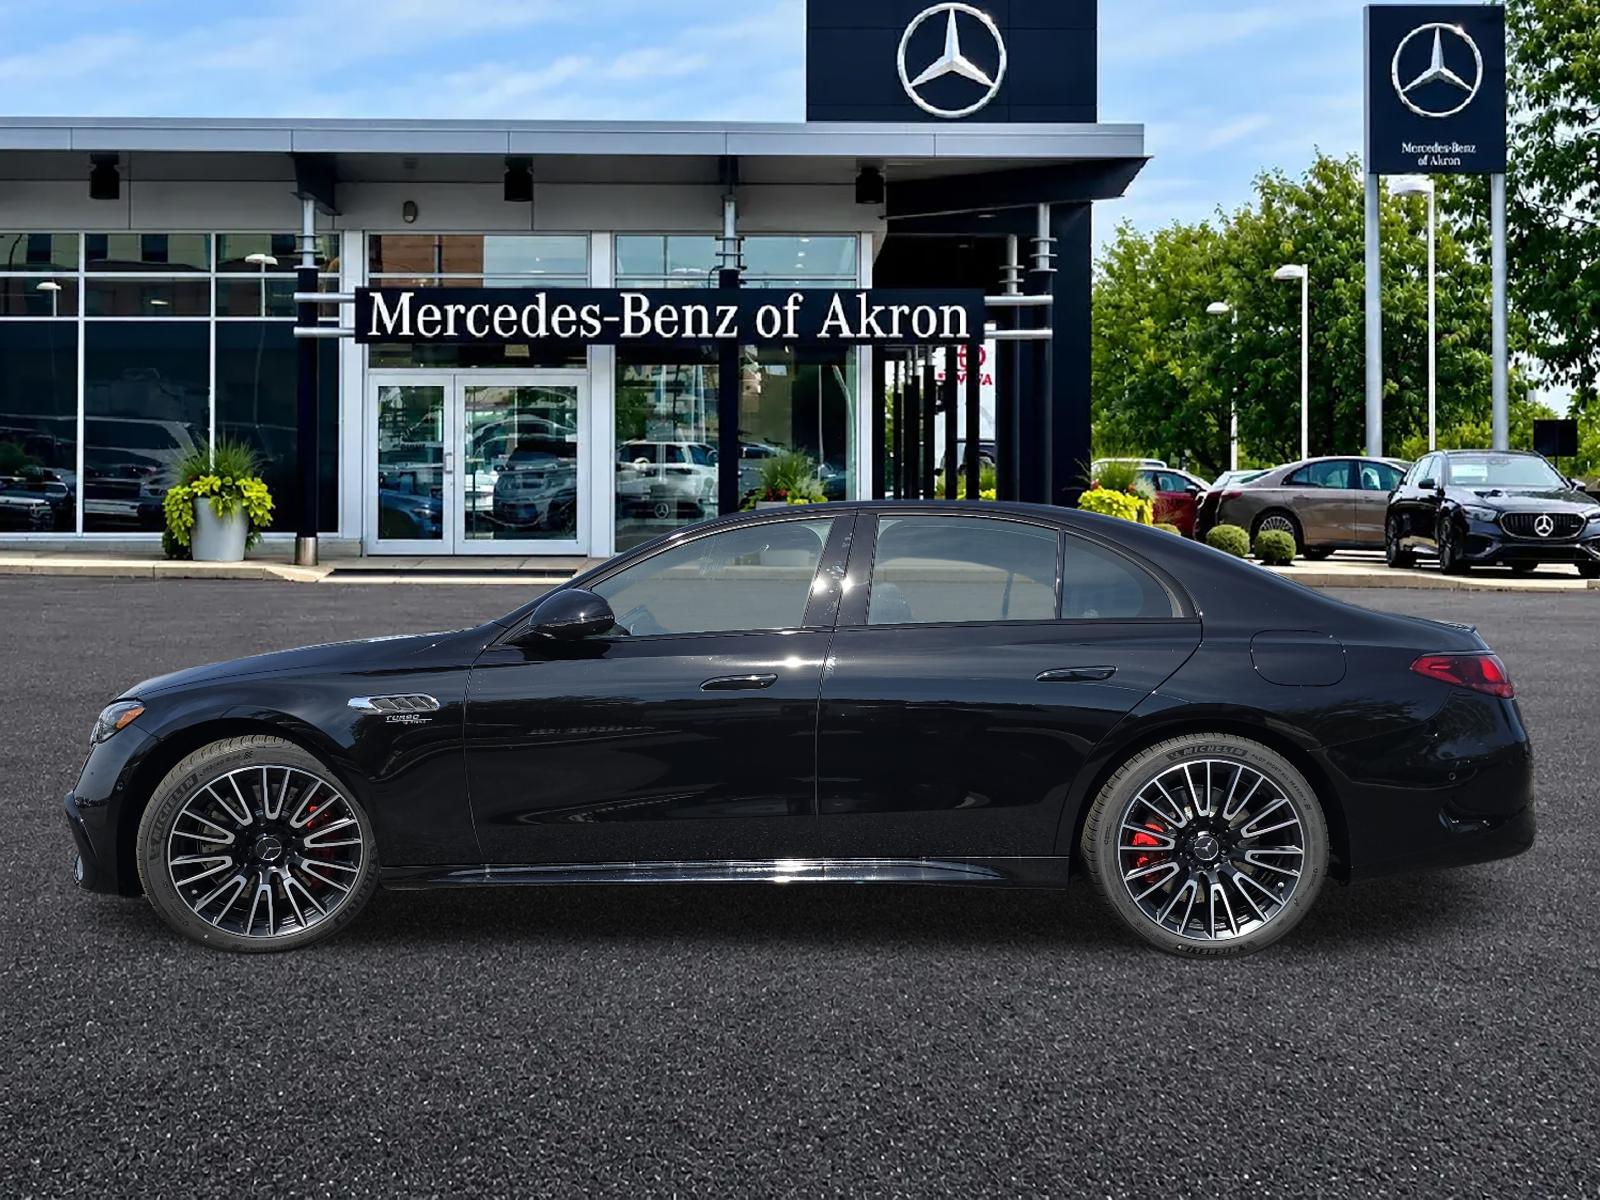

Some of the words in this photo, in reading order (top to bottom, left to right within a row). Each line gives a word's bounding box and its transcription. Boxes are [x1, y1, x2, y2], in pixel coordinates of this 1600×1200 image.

[1417, 154, 1429, 166] of
[1429, 154, 1461, 166] Akron
[367, 291, 738, 338] Mercedes-Benz
[755, 292, 804, 338] of
[817, 291, 971, 338] Akron
[152, 775, 197, 842] MICHELIN
